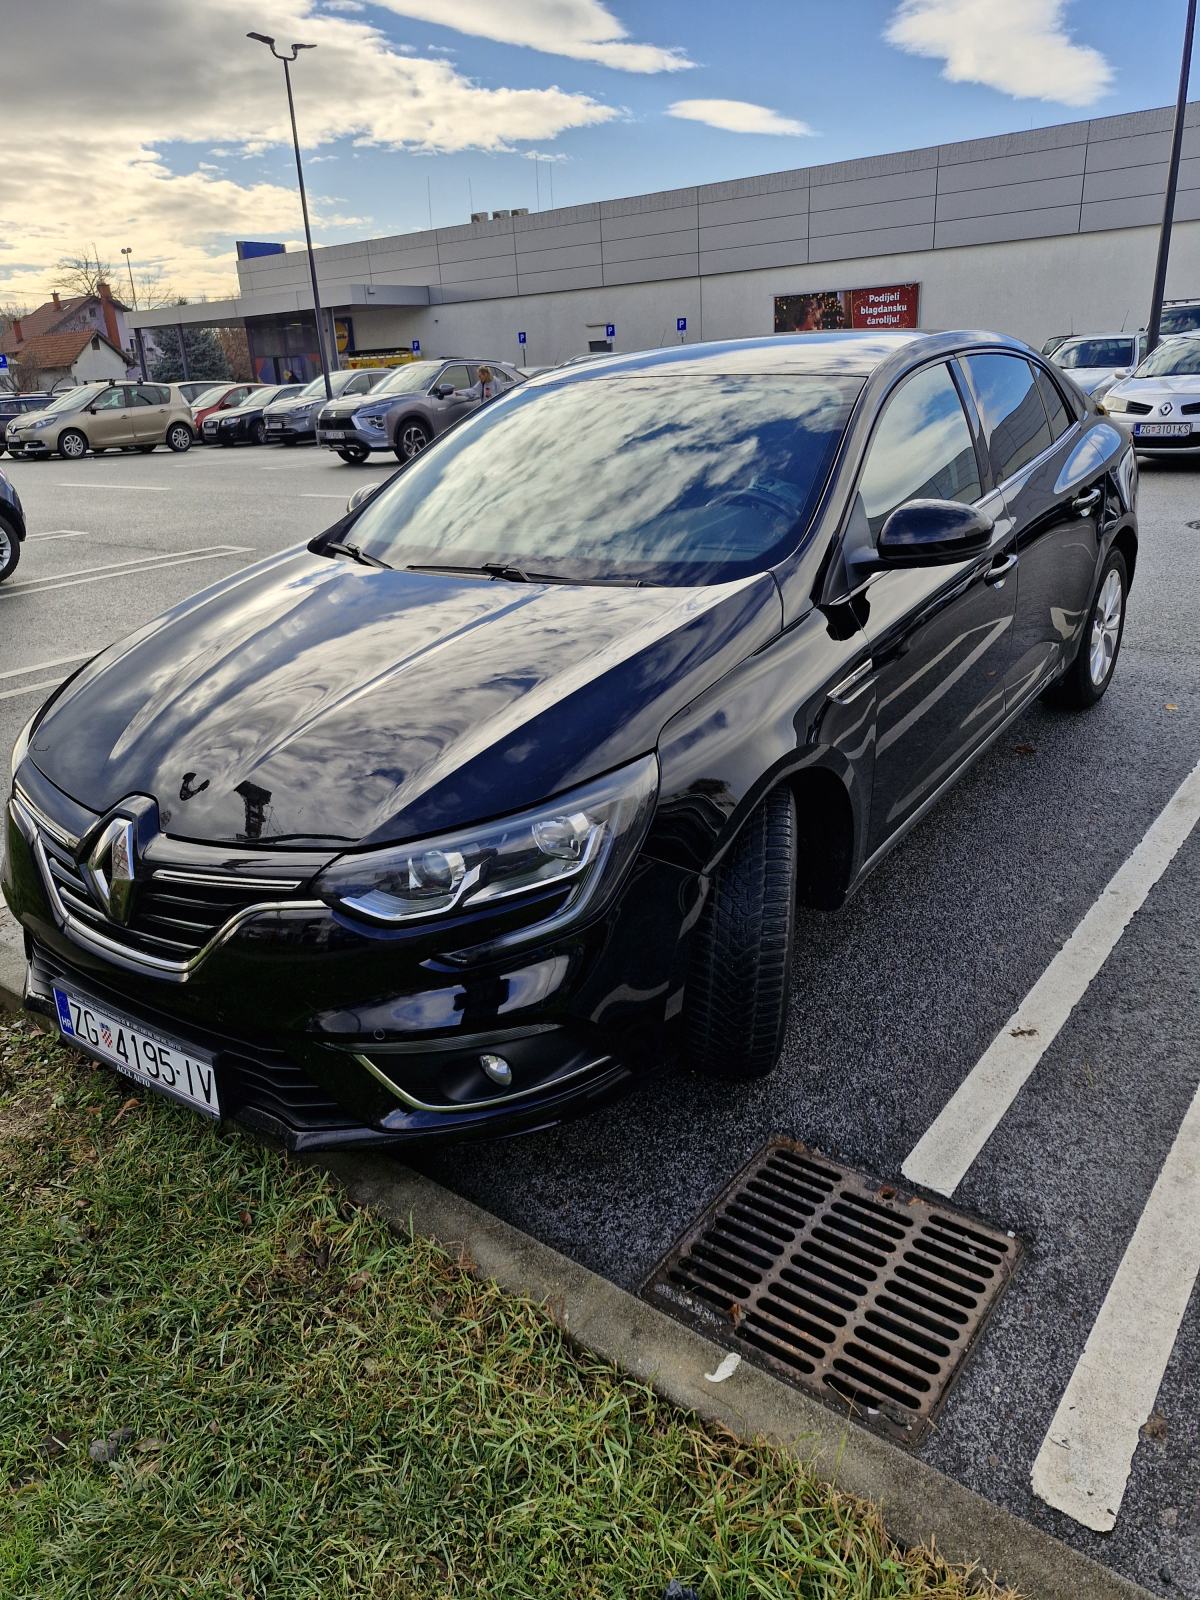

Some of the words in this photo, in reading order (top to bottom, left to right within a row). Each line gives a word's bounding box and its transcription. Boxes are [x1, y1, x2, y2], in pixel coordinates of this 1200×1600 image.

[869, 292, 900, 303] Podijeli
[860, 303, 907, 315] blagdansku
[1141, 425, 1150, 434] ZG
[61, 1016, 73, 1030] HR
[70, 1002, 99, 1046] ZG
